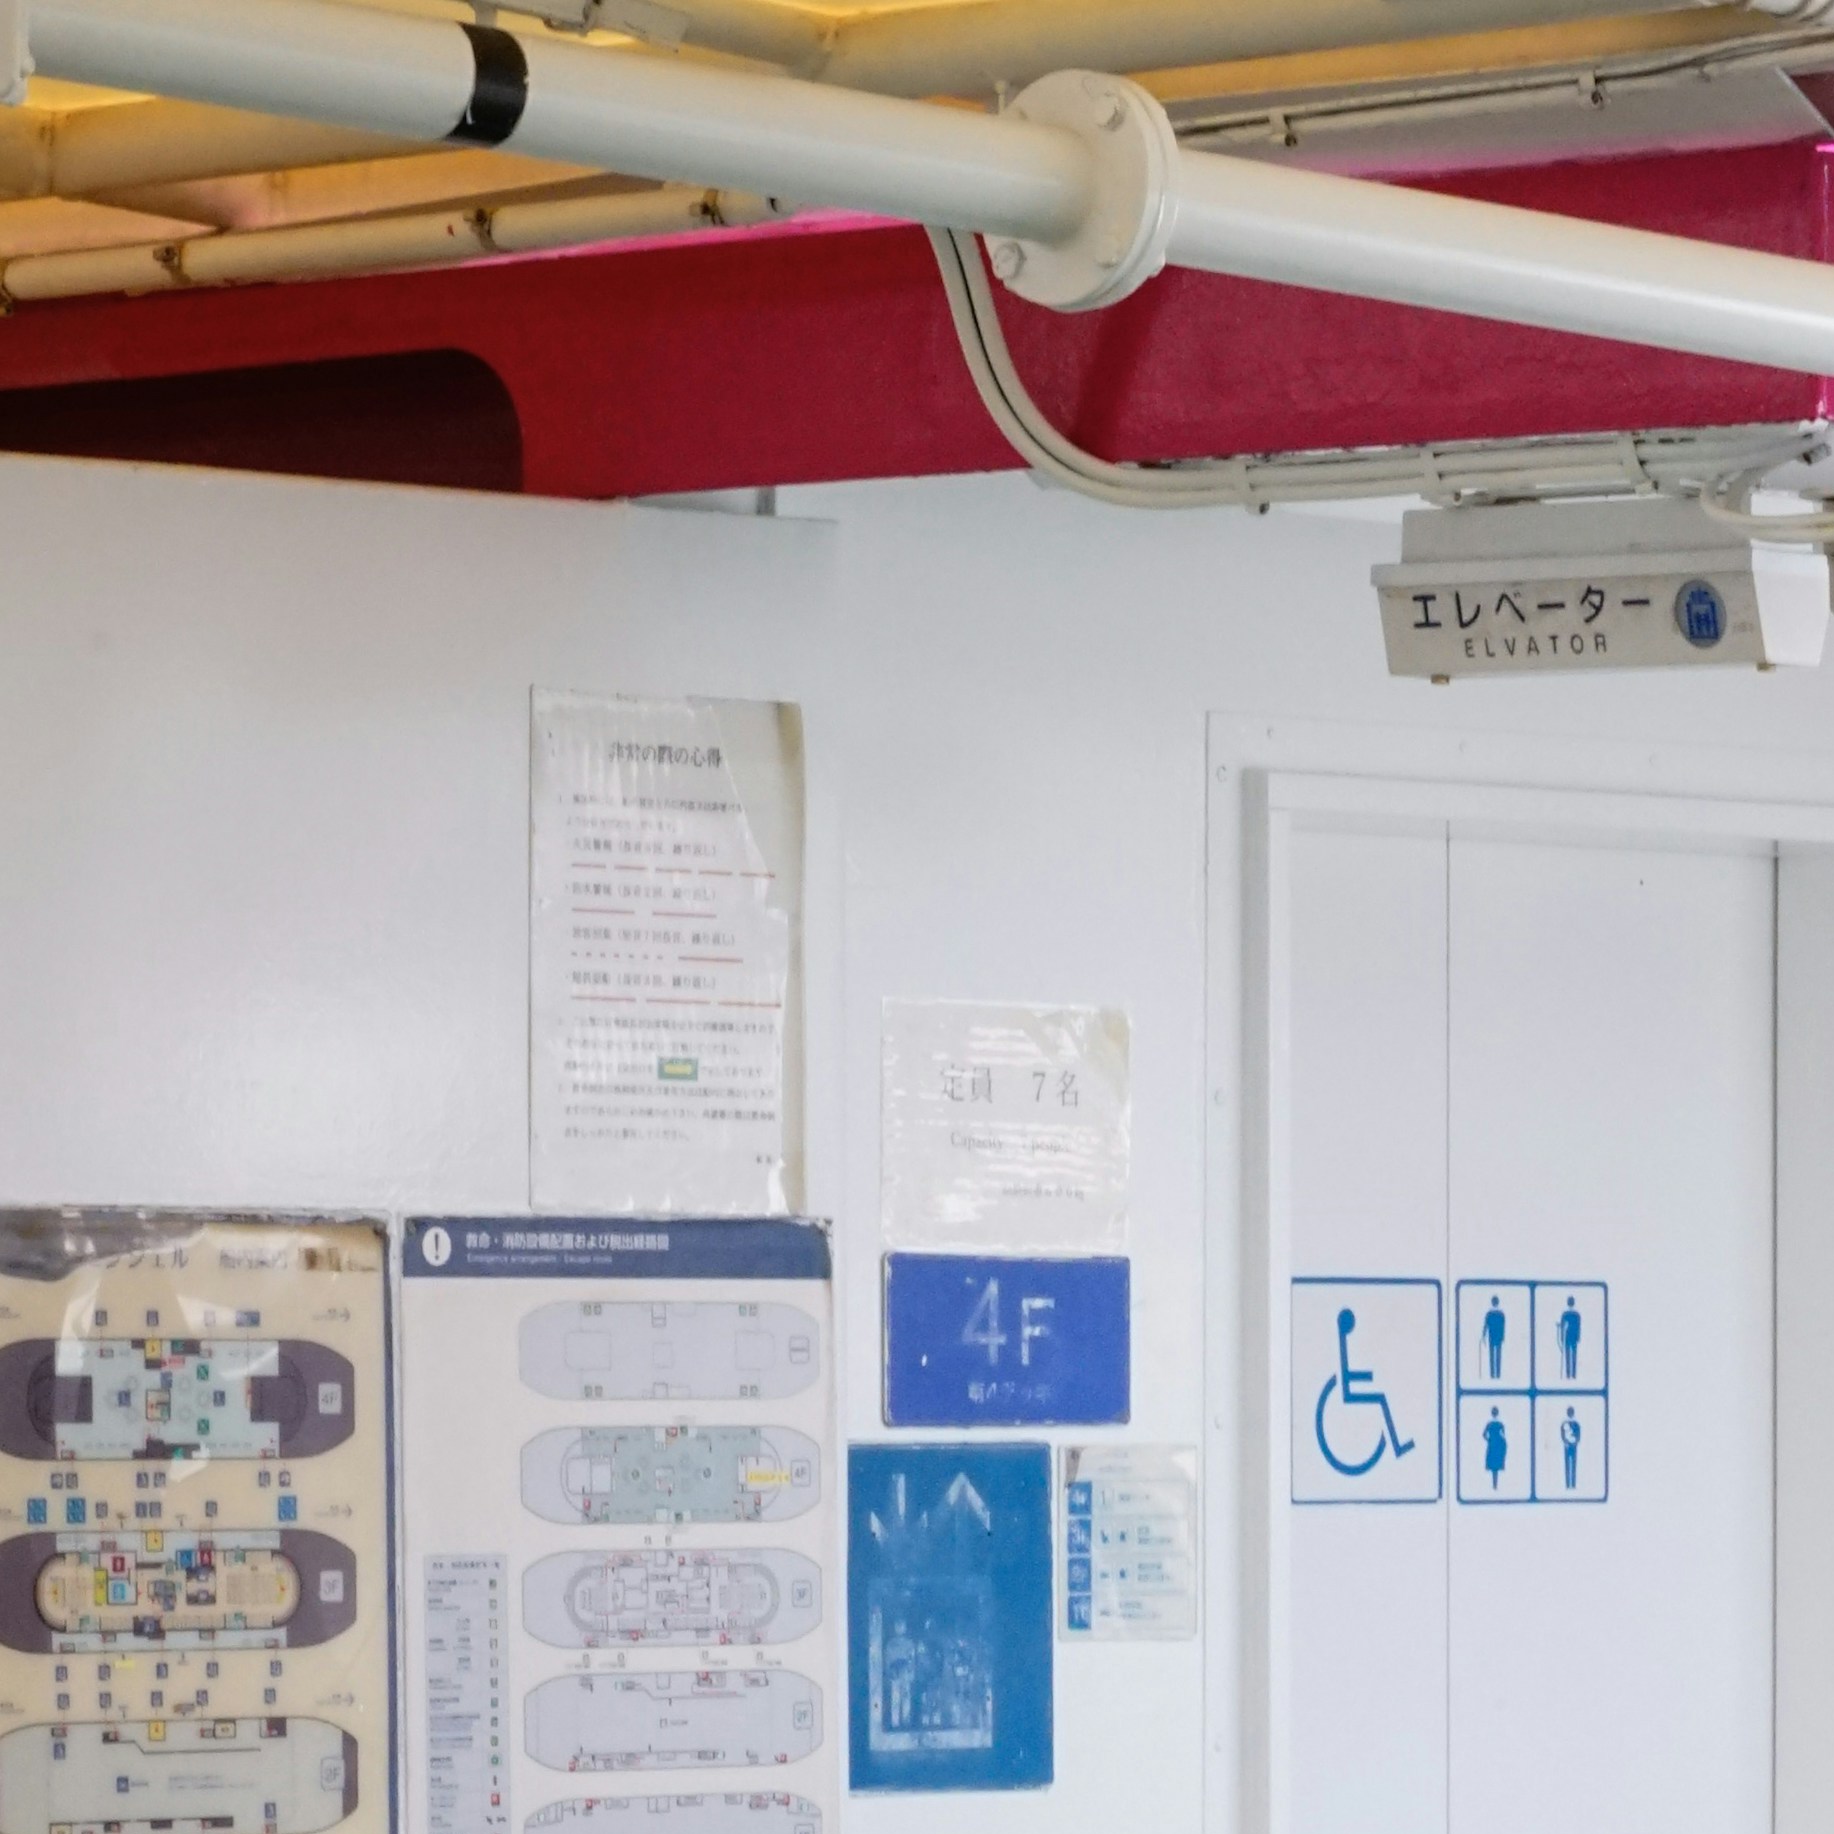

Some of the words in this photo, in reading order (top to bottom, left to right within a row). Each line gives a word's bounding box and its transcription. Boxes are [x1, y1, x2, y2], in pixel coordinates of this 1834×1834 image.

[1413, 585, 1650, 629] エレベーター
[1465, 635, 1607, 659] ELVATOR
[940, 1064, 993, 1104] 定員
[961, 1277, 1055, 1366] 4F
